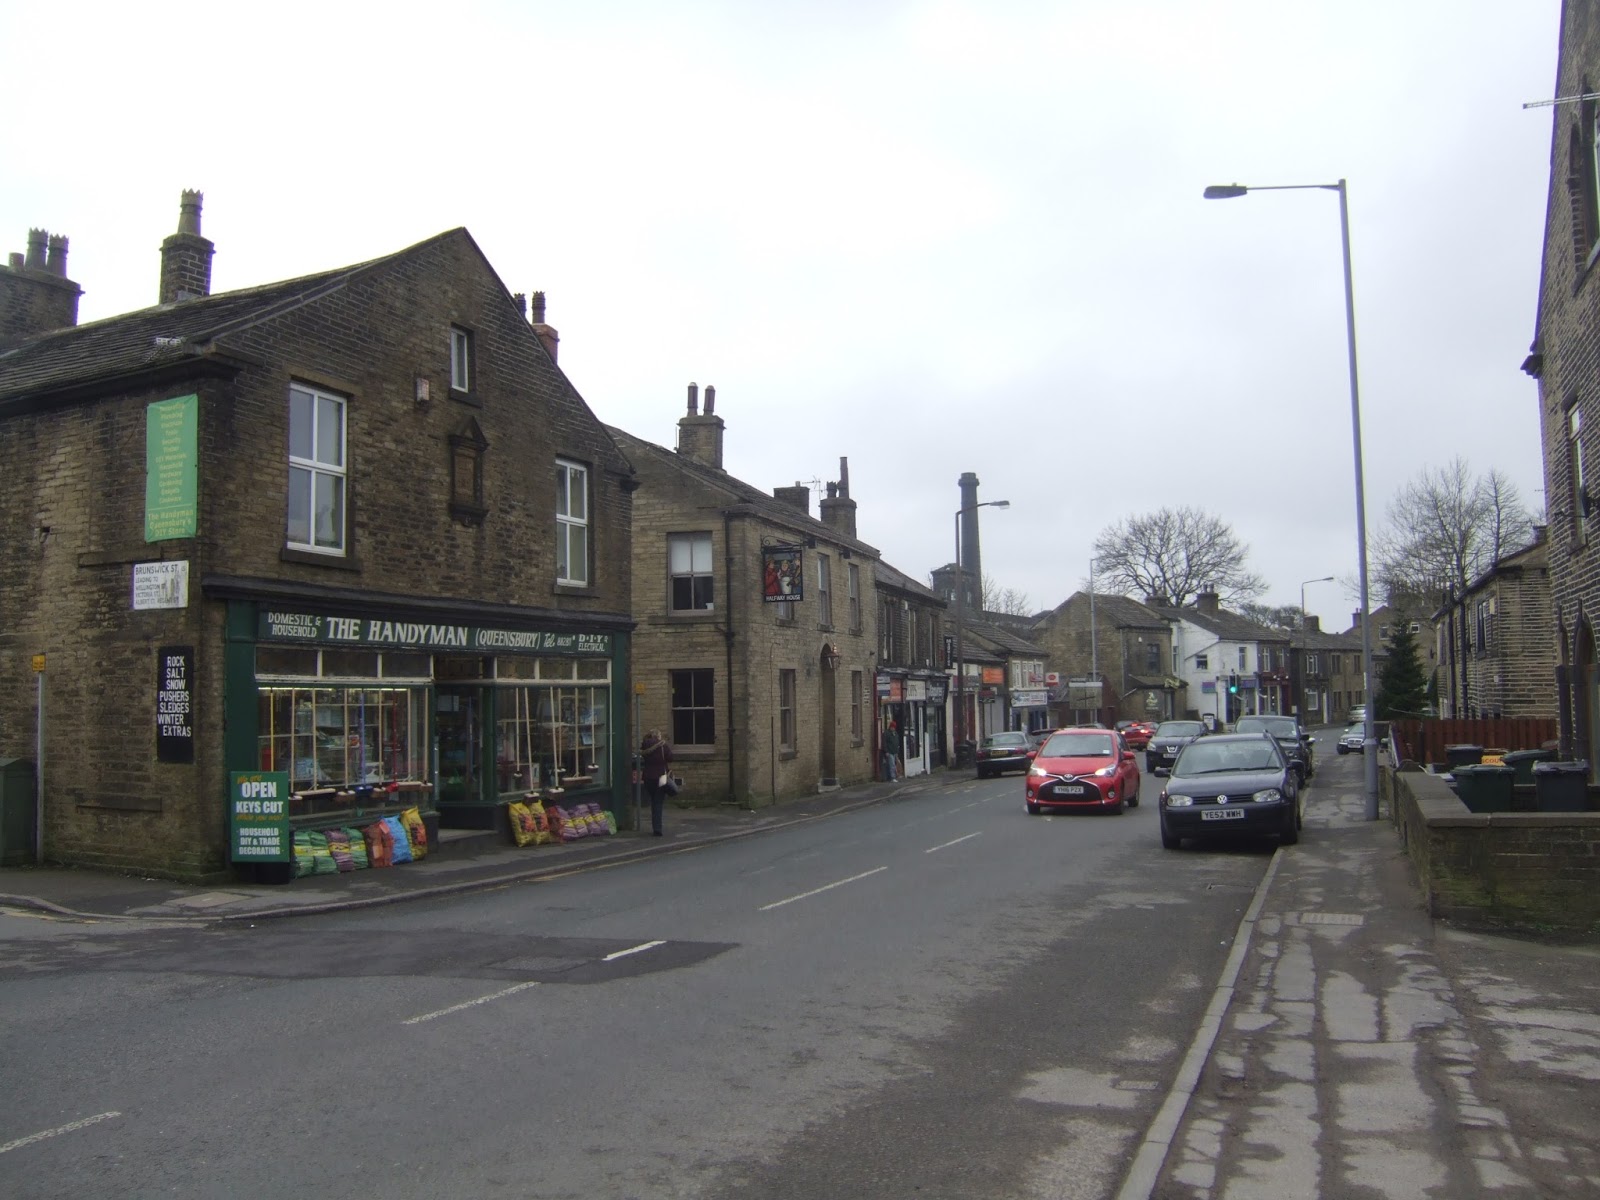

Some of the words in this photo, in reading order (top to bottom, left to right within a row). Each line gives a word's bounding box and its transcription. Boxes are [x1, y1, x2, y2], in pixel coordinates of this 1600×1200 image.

[135, 565, 169, 575] BRUNSWICK
[268, 612, 313, 626] DOMESTIC
[271, 624, 317, 638] HOUSEHOLD
[326, 617, 361, 640] THE
[367, 620, 468, 646] HANDYMAN
[166, 656, 185, 667] ROCK
[166, 667, 185, 679] SALT
[166, 679, 186, 690] SNOW
[159, 691, 190, 702] PUSHERS
[159, 702, 190, 713] SLEDGES
[157, 714, 184, 725] WINTER
[162, 726, 192, 737] EXTRAS
[241, 781, 278, 798] OPEN
[235, 801, 262, 813] KEYS
[262, 801, 284, 814] CUT
[1204, 811, 1225, 819] YE52
[239, 828, 279, 836] HOUSEHOLD
[240, 837, 252, 846] DIY
[259, 837, 281, 846] TRADE
[238, 846, 281, 856] DECORATING
